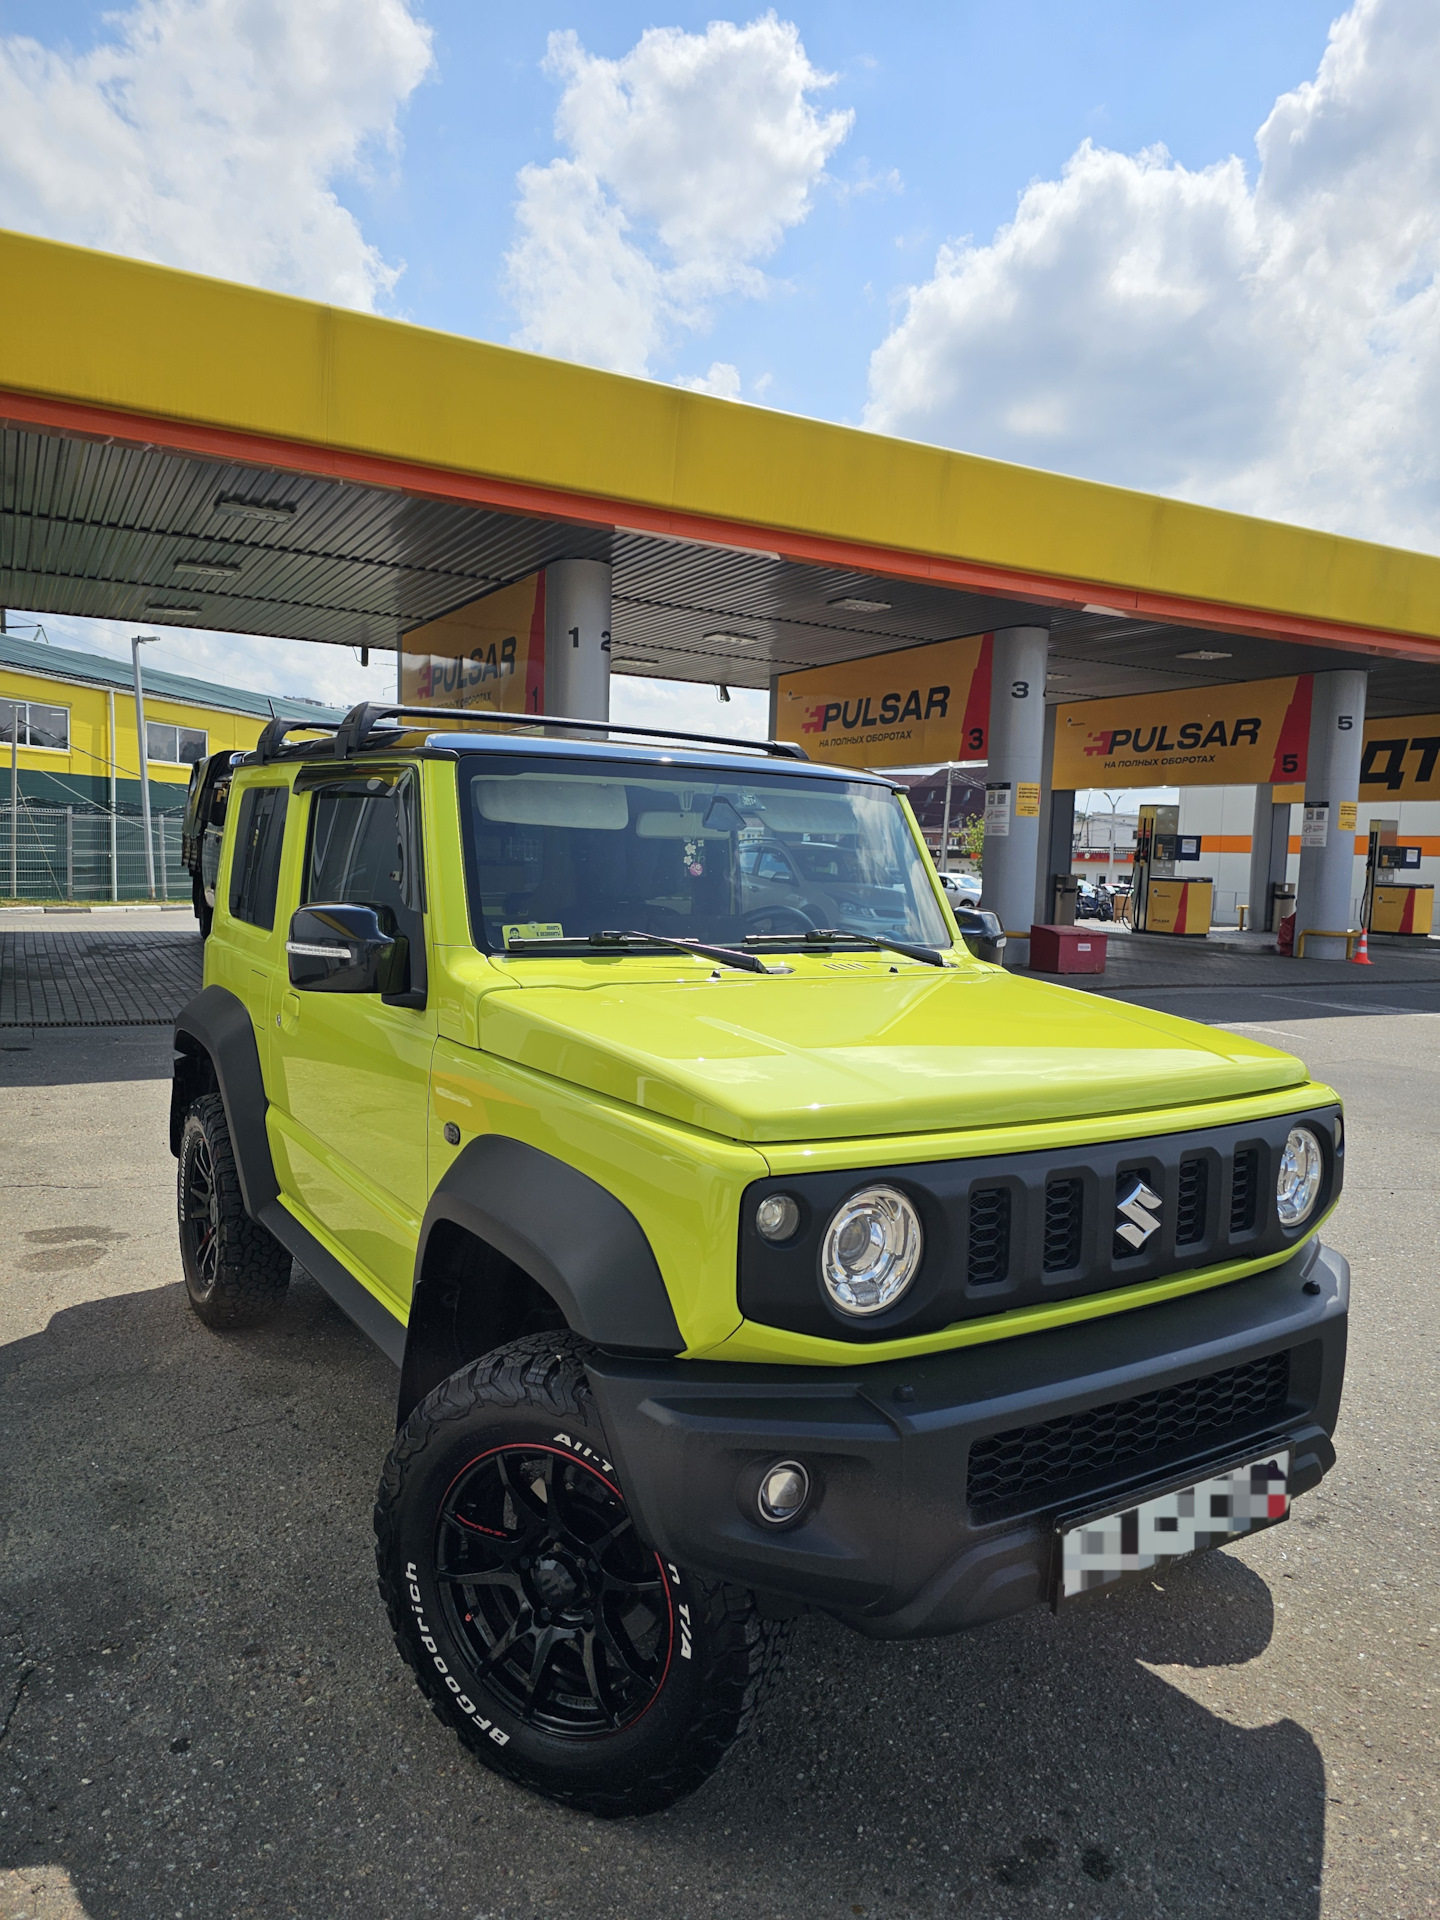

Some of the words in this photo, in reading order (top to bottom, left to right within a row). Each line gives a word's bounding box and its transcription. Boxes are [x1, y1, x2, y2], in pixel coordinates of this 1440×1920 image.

[568, 626, 579, 648] 1
[600, 630, 610, 652] 2
[431, 636, 517, 697] PULSAR
[532, 686, 538, 713] 1
[1011, 681, 1029, 698] 3
[822, 685, 951, 732] PULSAR
[1337, 715, 1353, 731] 5
[819, 739, 829, 748] НА
[830, 735, 865, 747] ПОЛНЫХ
[866, 730, 913, 743] ОБОРОТАХ
[968, 728, 984, 750] 3
[1107, 718, 1262, 755] PULSAR
[1104, 761, 1116, 769] НА
[1118, 759, 1159, 768] ПОЛНЫХ
[1160, 755, 1216, 766] ОБОРОТАХ
[1281, 753, 1299, 774] 5
[1360, 736, 1440, 790] ДТ
[678, 1604, 692, 1660] T/A
[405, 1562, 510, 1746] BFGoodrich
